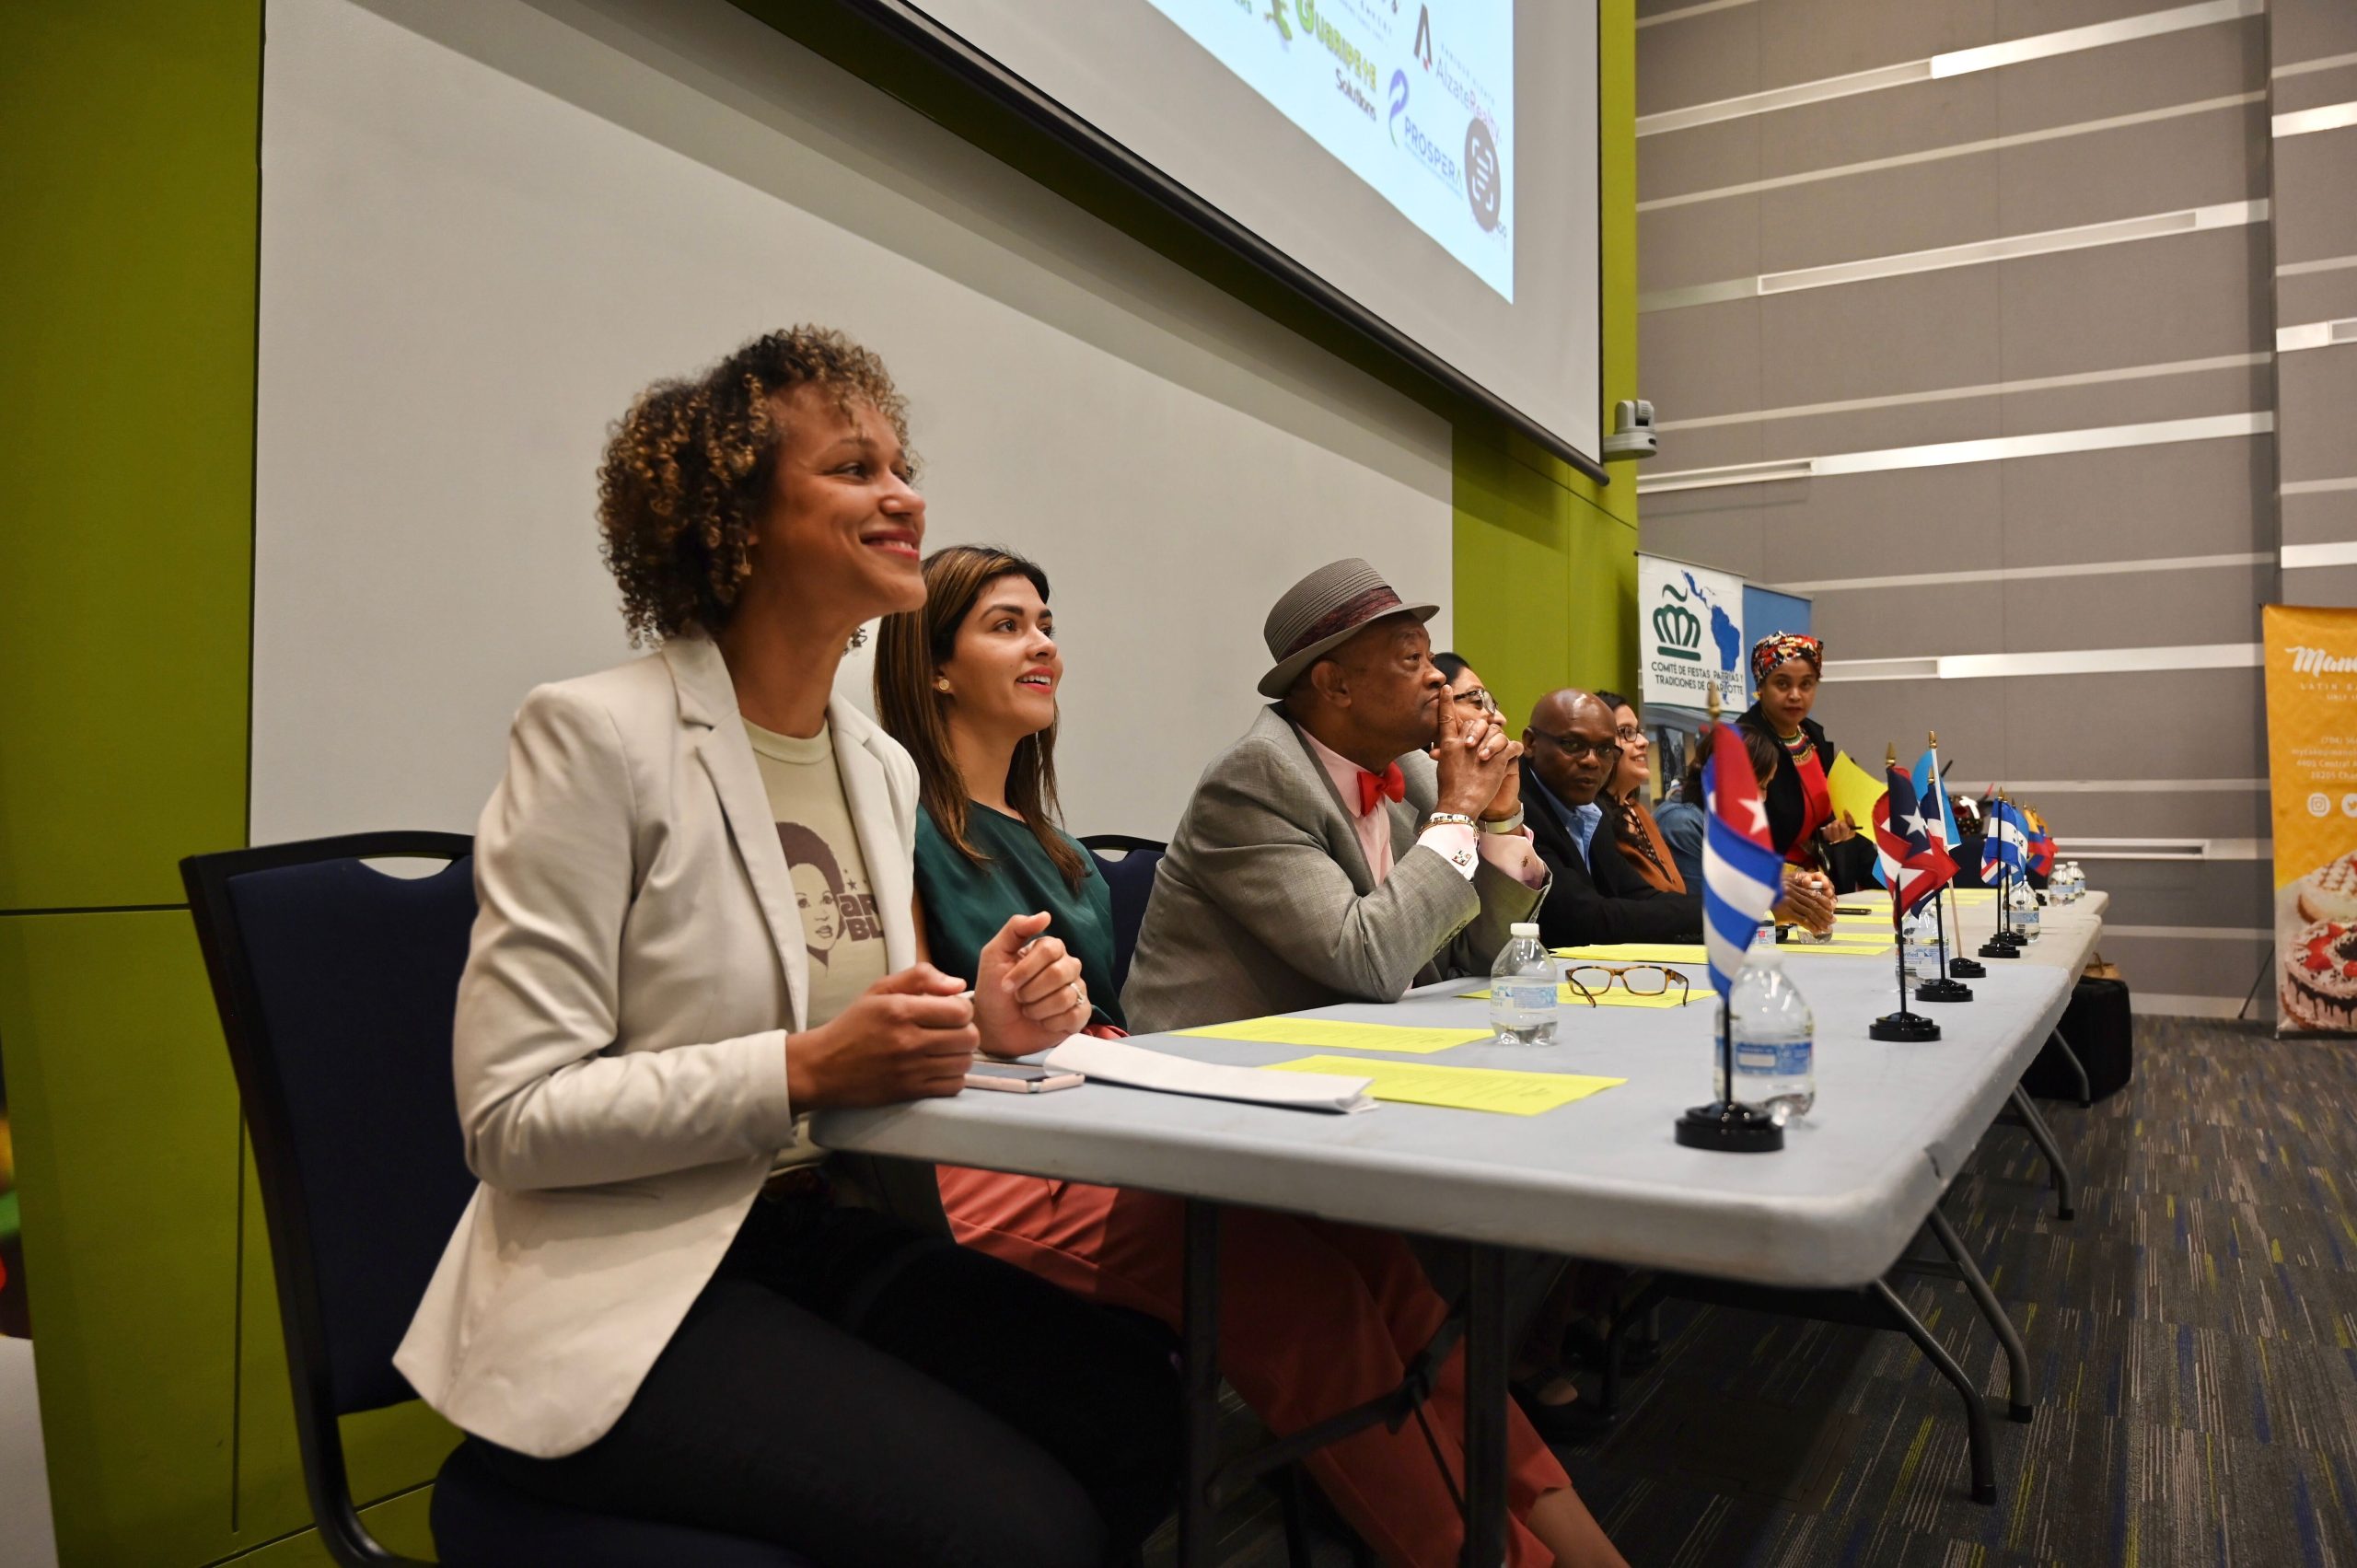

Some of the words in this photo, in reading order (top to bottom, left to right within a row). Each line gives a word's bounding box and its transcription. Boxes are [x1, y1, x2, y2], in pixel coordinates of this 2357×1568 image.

[1405, 115, 1463, 192] PROSPERA
[1655, 674, 1696, 690] TRADICIONES
[1698, 681, 1705, 691] DE
[1707, 681, 1744, 695] CARLOTTE
[1678, 666, 1687, 676] DE
[1688, 667, 1711, 679] FIESTAS
[1713, 670, 1738, 682] PATRIAS
[1739, 674, 1744, 682] Y
